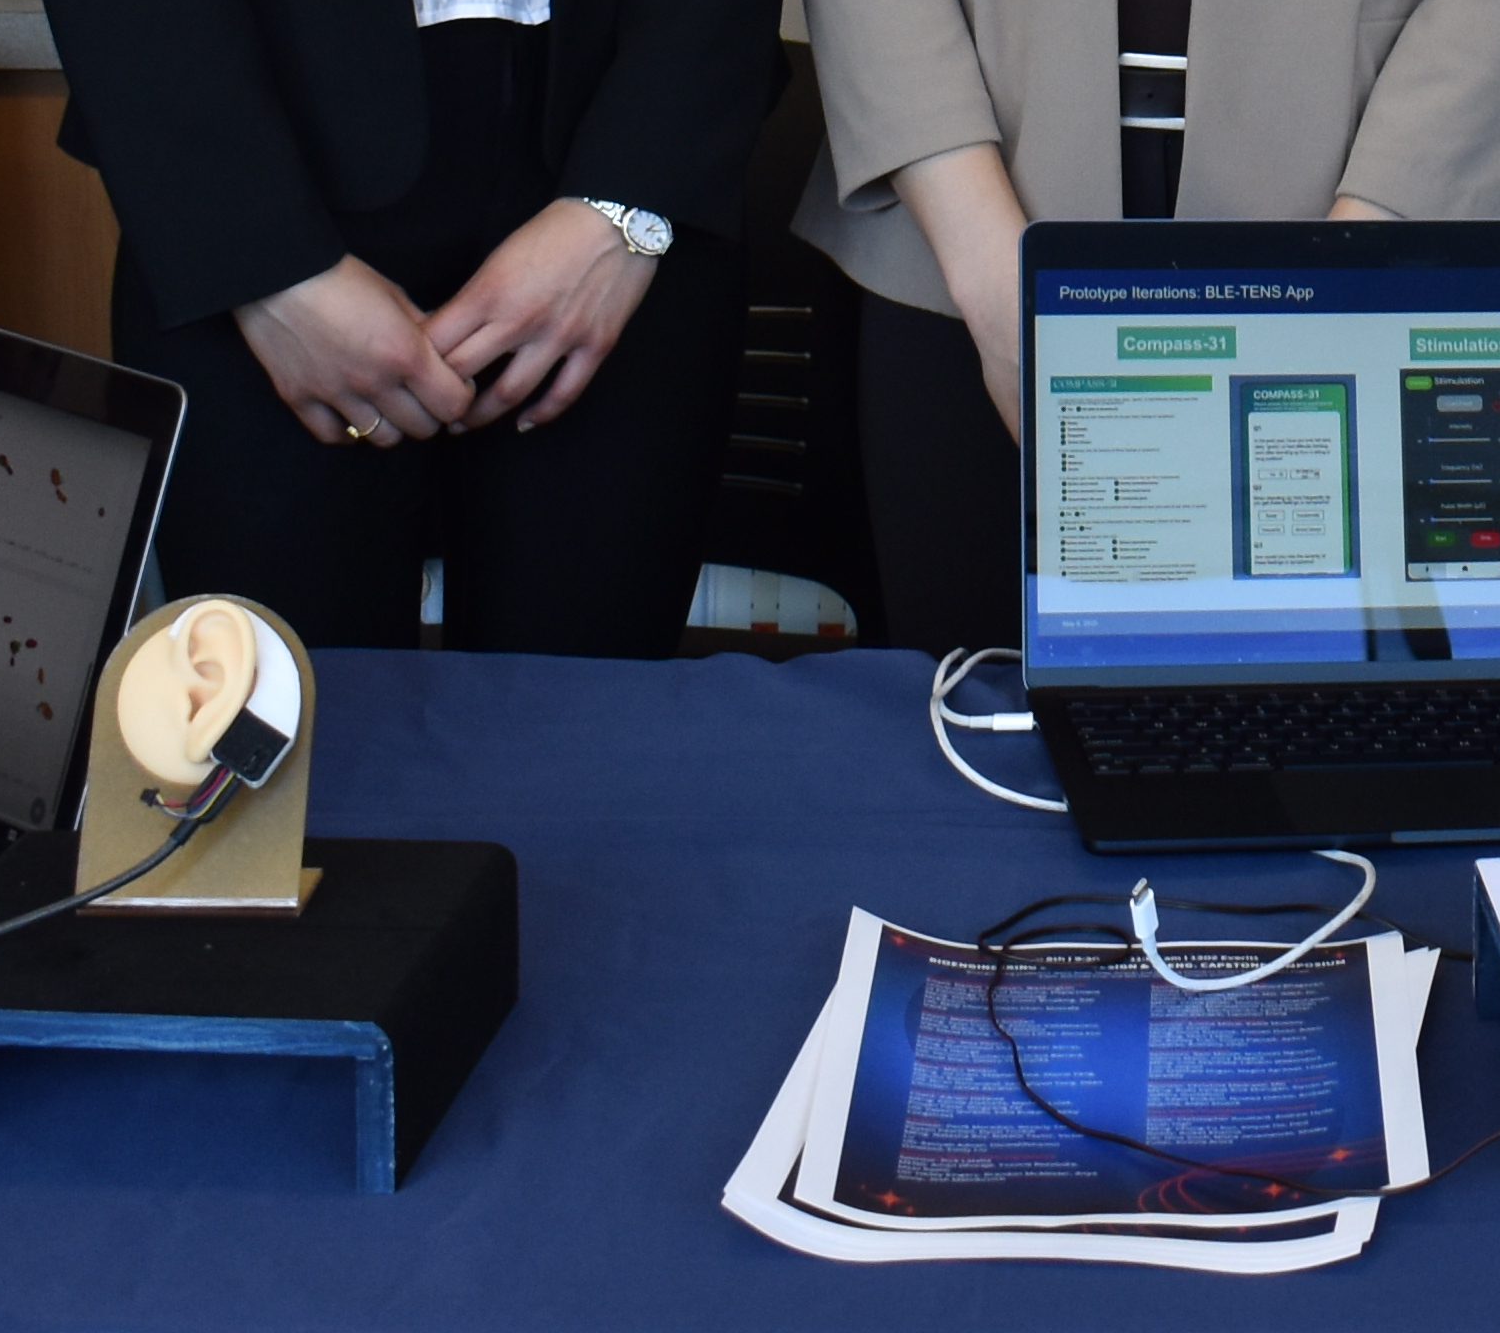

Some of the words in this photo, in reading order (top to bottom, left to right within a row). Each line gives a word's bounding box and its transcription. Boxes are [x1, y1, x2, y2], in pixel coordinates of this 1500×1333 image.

[1059, 285, 1127, 302] Prototype
[1131, 285, 1200, 299] Iterations:
[1205, 284, 1281, 299] BLE-TENS
[1285, 285, 1314, 301] App
[1123, 335, 1226, 355] Compass-31
[1253, 389, 1319, 400] COMPASS-31
